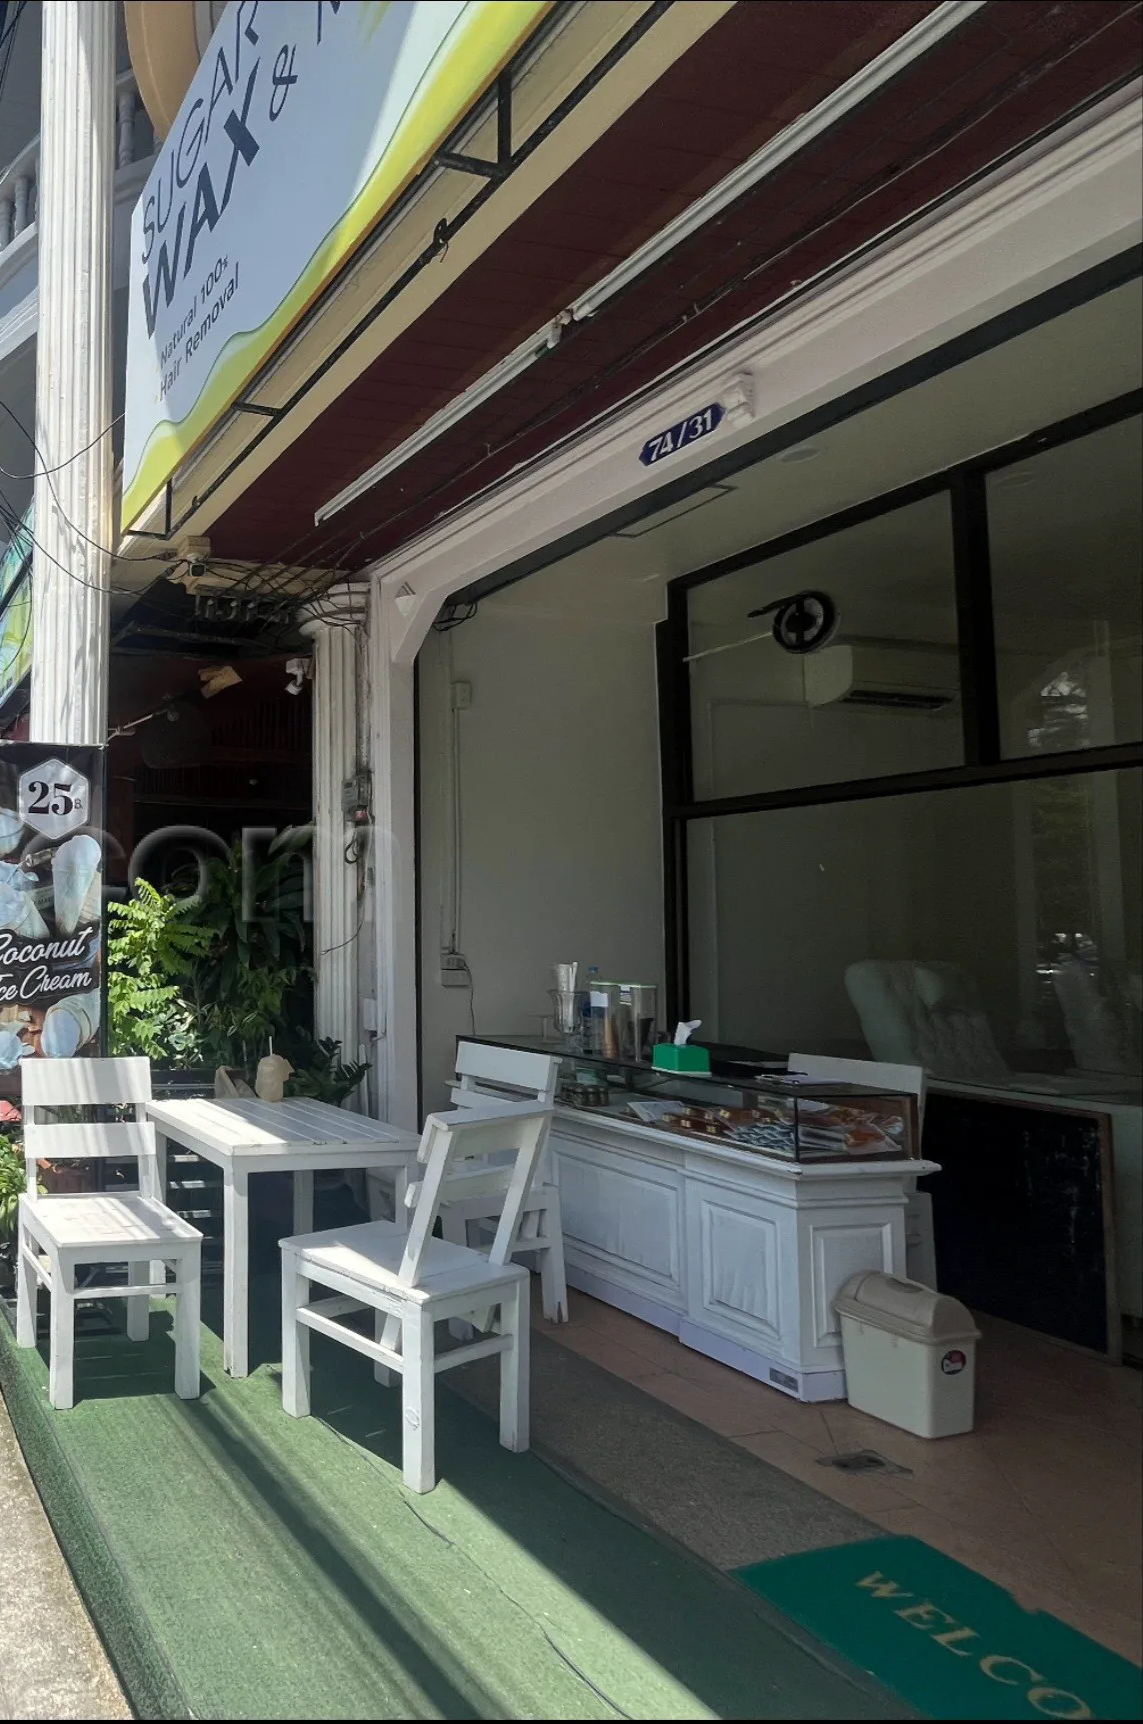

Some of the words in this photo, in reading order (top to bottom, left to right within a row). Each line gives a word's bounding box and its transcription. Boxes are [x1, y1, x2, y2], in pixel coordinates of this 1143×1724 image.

[143, 1, 259, 264] SUGAR
[142, 57, 260, 339] WAX
[269, 43, 298, 122] &
[159, 358, 183, 403] Hair
[185, 261, 241, 364] Removal
[160, 296, 198, 371] Natural
[649, 409, 713, 462] 74/31
[19, 965, 92, 999] Cream
